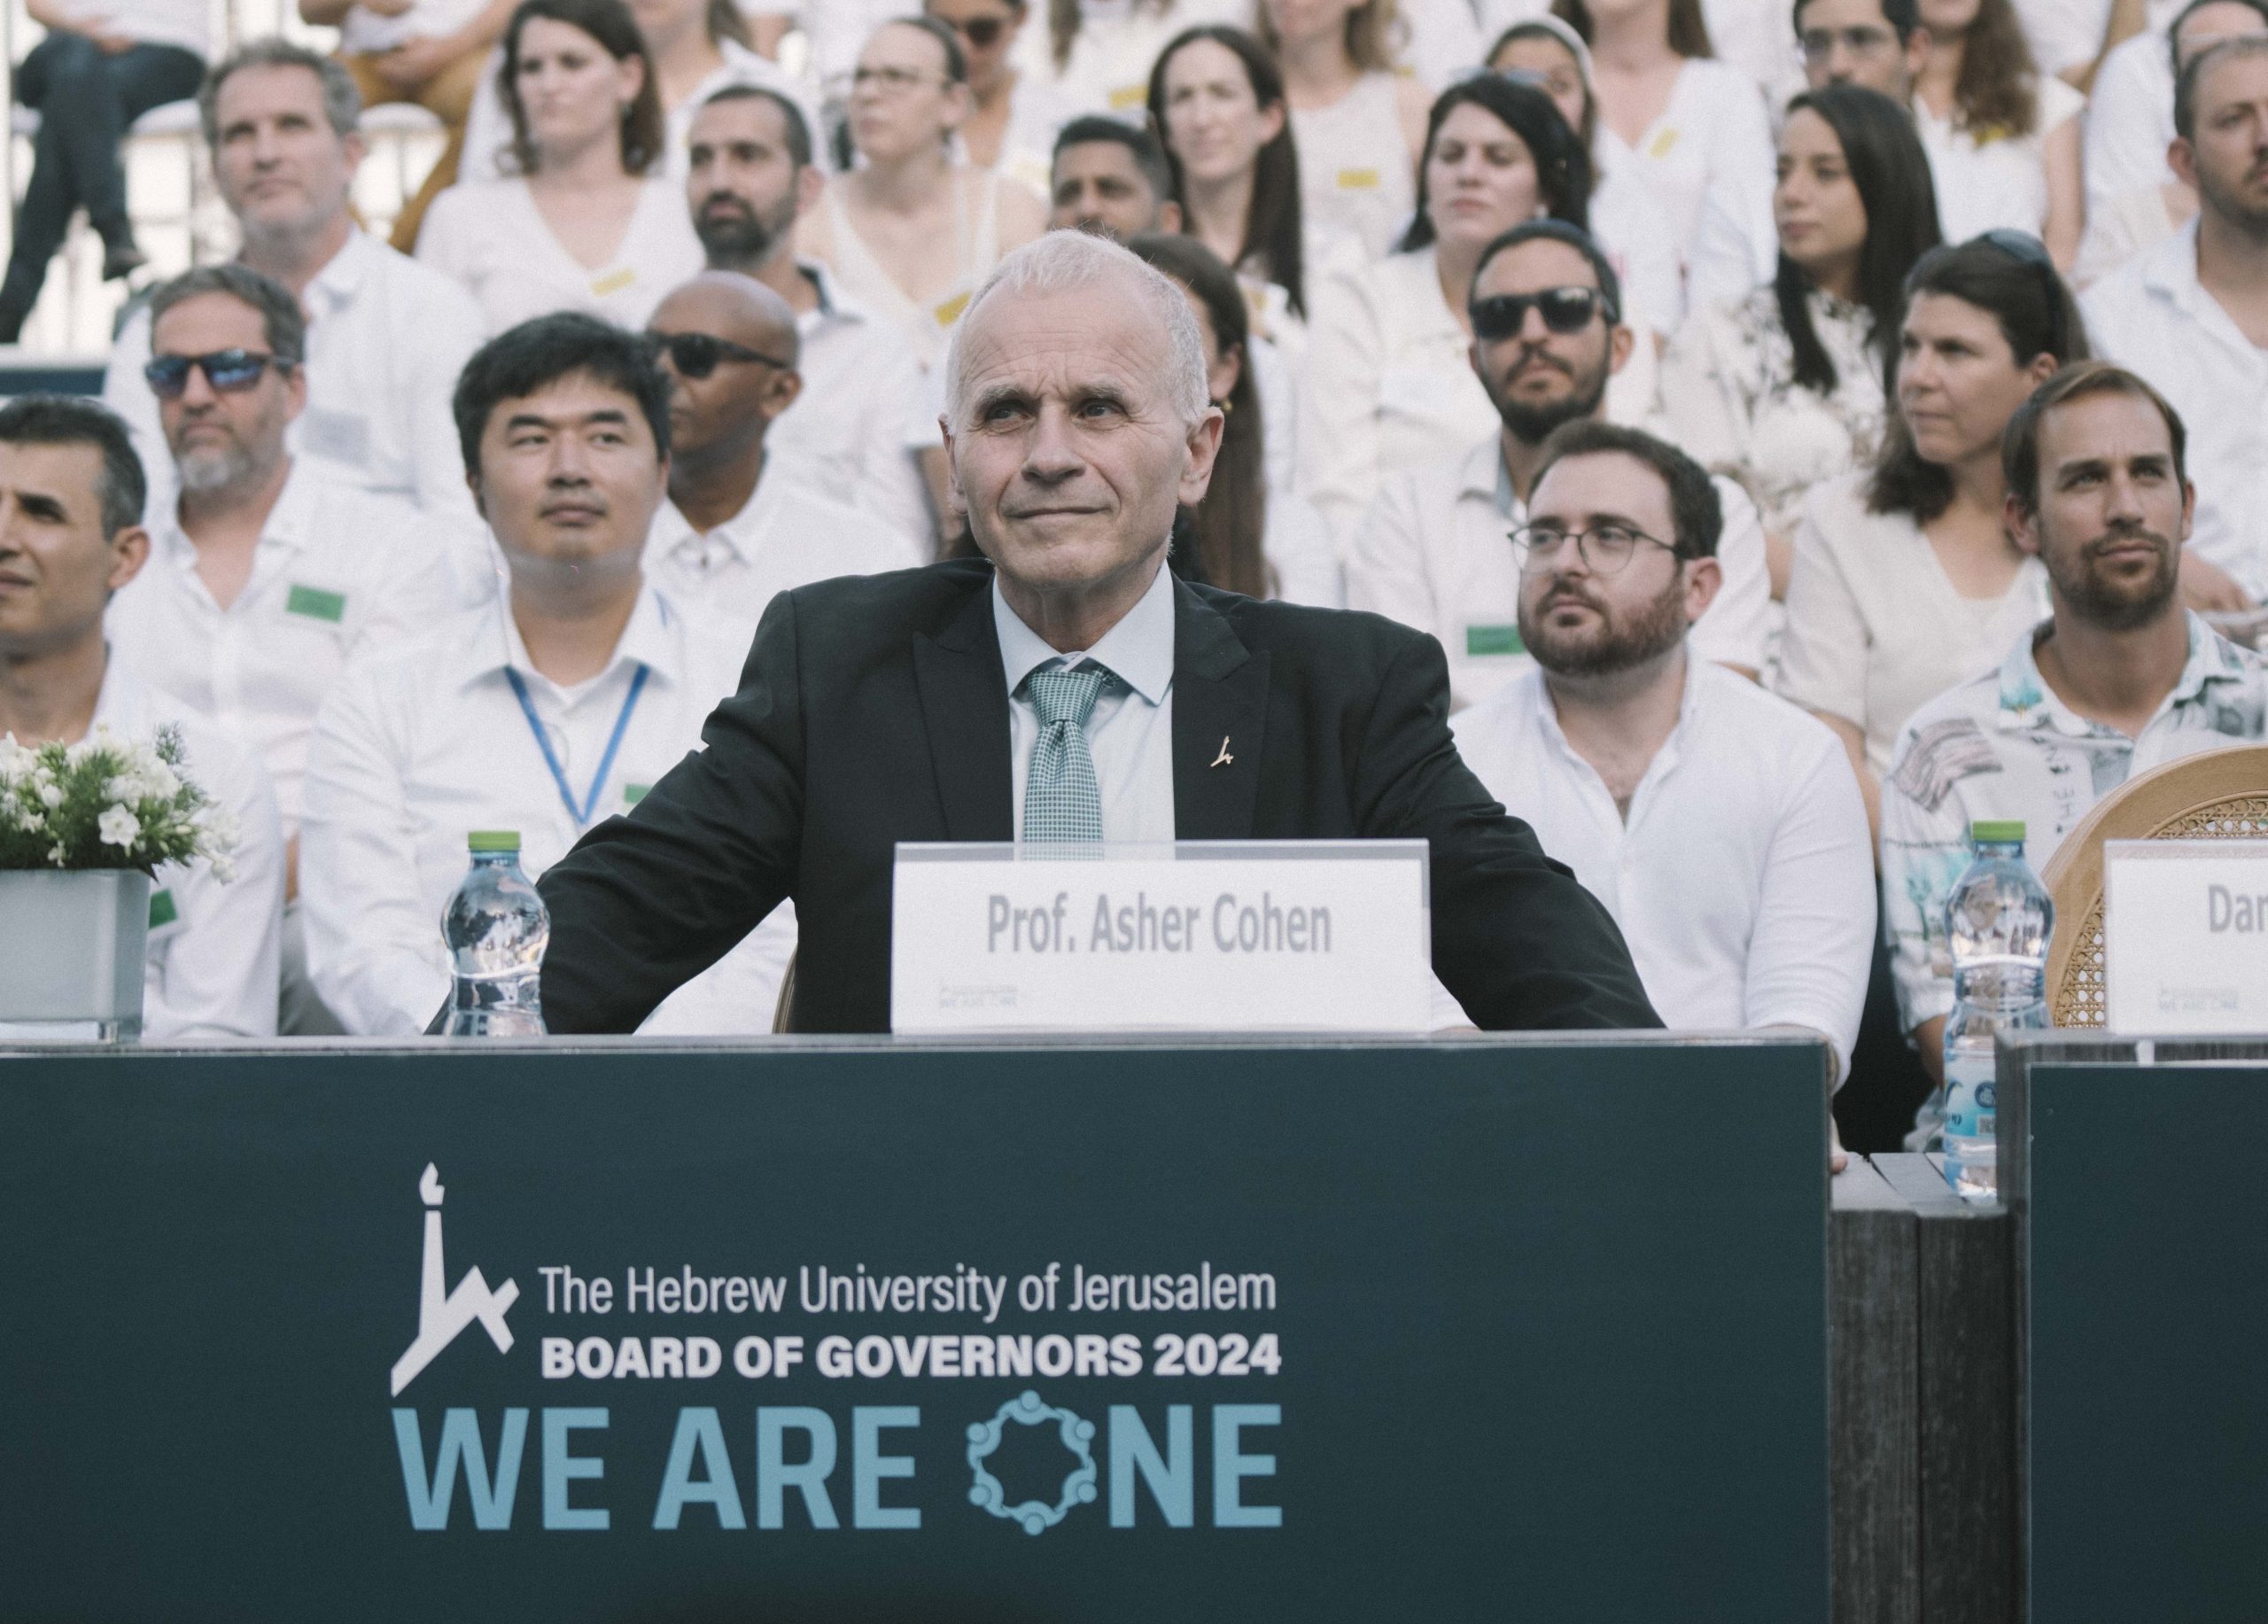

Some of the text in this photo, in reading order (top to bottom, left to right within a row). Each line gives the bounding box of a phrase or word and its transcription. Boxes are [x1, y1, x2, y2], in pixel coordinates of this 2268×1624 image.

[987, 891, 1332, 953] Prof. Asher Cohen
[539, 1262, 1277, 1324] The Hebrew University of Jerusalem
[542, 1333, 1282, 1379] BOARD OF GOVERNORS 2024
[392, 1407, 610, 1530] WE
[653, 1406, 920, 1529] ARE
